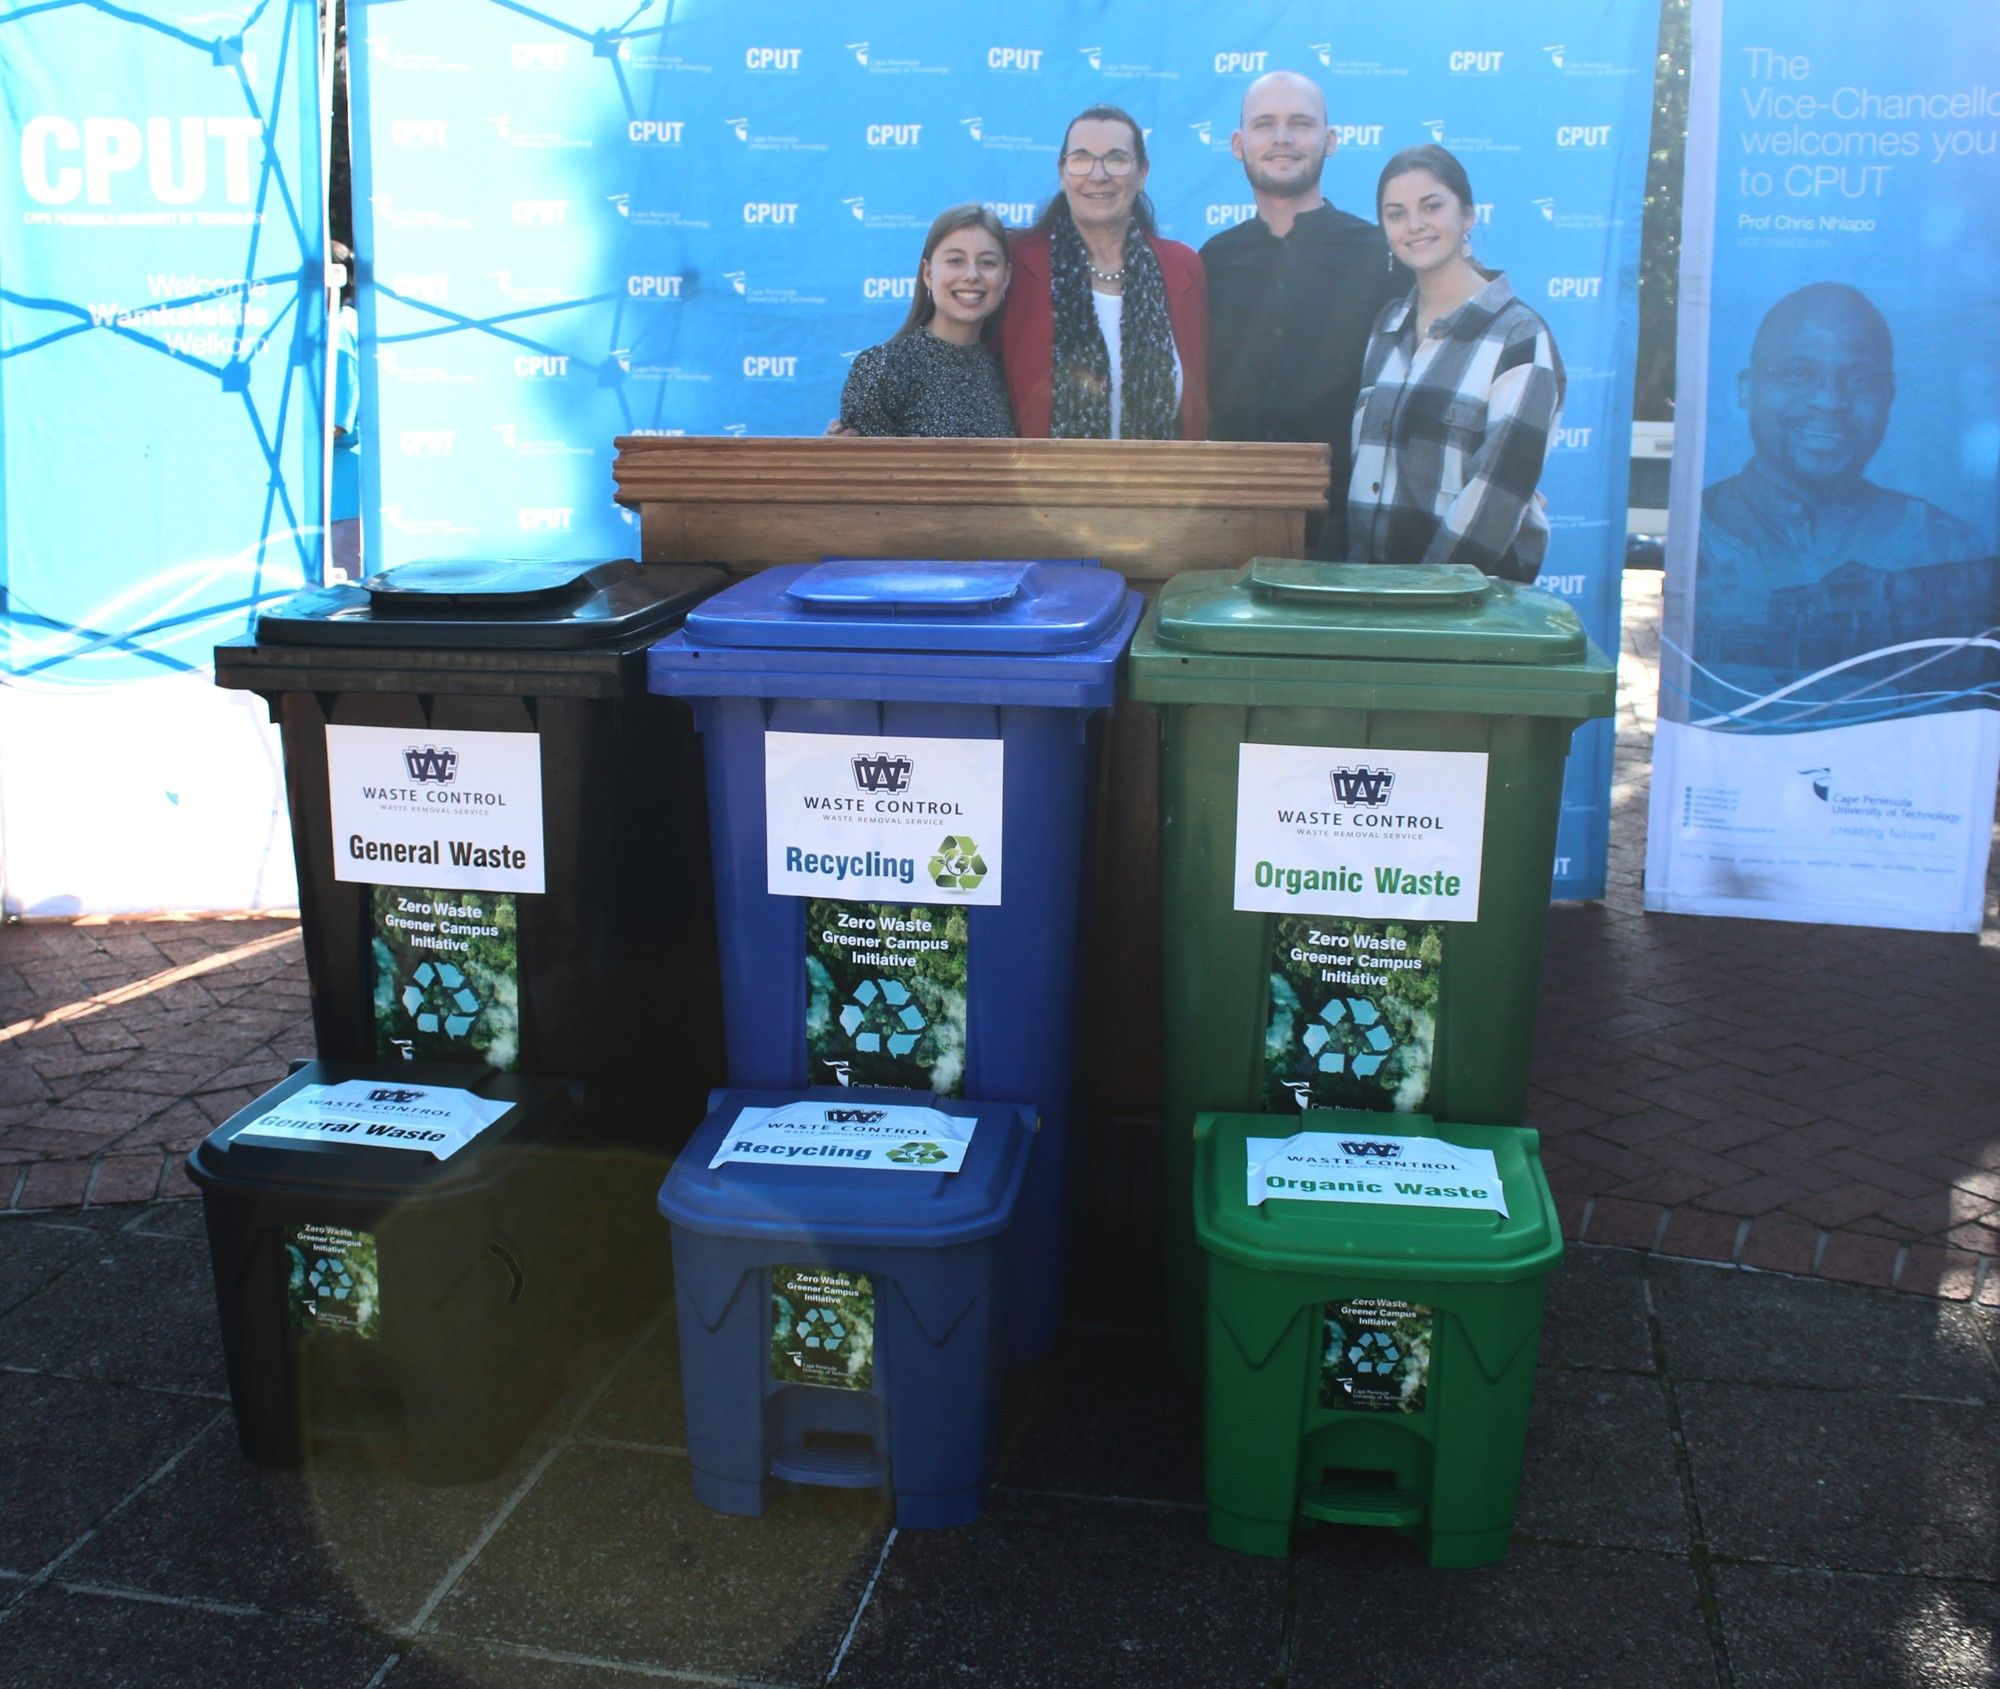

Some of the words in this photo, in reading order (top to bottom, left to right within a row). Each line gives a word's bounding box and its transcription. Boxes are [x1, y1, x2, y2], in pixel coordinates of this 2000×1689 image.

[745, 48, 801, 69] CPUT
[987, 47, 1043, 70] CPUT
[1214, 51, 1268, 73] CPUT
[1450, 51, 1503, 72] CPUT
[1744, 47, 1810, 80] The
[628, 120, 684, 142] CPUT
[866, 124, 922, 145] CPUT
[1556, 126, 1611, 147] CPUT
[1740, 127, 1920, 156] welcomes
[1932, 129, 1998, 163] you
[21, 115, 263, 205] CPUT
[1738, 166, 1772, 197] to
[1784, 164, 1891, 198] CPUT
[743, 203, 798, 224] CPUT
[1738, 214, 1770, 230] Prof
[1775, 214, 1815, 231] Chris
[147, 273, 269, 297] Welcome
[627, 275, 682, 297] CPUT
[863, 277, 916, 299] CPUT
[1548, 277, 1602, 298] CPUT
[163, 331, 269, 356] Welkom
[515, 355, 570, 377] CPUT
[743, 356, 798, 378] CPUT
[1552, 428, 1592, 448] PUT
[519, 508, 574, 530] CPUT
[362, 787, 417, 801] WASTE
[426, 790, 506, 806] CONTROL
[803, 796, 865, 812] WASTE
[875, 799, 964, 816] CONTROL
[1833, 793, 1859, 805] Cape
[1864, 795, 1913, 808] Peninsula
[379, 804, 408, 812] WASTE
[411, 806, 450, 814] REMOVAL
[454, 808, 489, 816] SERVICE
[822, 814, 853, 823] WASTE
[857, 816, 902, 825] REMOVAL
[905, 818, 944, 826] SERVICE
[1278, 810, 1342, 826] WASTE
[1353, 813, 1444, 830] CONTROL
[1832, 805, 1882, 818] University
[1887, 808, 1897, 817] of
[1901, 809, 1961, 824] Technology
[1296, 828, 1329, 837] WASTE
[1334, 830, 1380, 839] REMOVAL
[1383, 832, 1424, 841] SERVICE
[349, 834, 440, 865] General
[449, 841, 526, 870] Waste
[785, 846, 915, 884] Recycling
[1255, 860, 1363, 896] Organic
[1374, 867, 1461, 897] Waste
[397, 897, 431, 915] Zero
[434, 902, 483, 919] Waste
[385, 914, 436, 932] Greener
[440, 921, 499, 938] Campus
[837, 913, 876, 930] Zero
[879, 917, 932, 933] Waste
[410, 934, 469, 952] Initiative
[822, 931, 881, 948] Greener
[886, 937, 949, 952] Campus
[1308, 930, 1349, 948] Zero
[1353, 934, 1407, 951] Waste
[852, 951, 917, 967] Initiative
[1290, 947, 1353, 966] Greener
[1358, 954, 1423, 972] Campus
[1321, 969, 1389, 986] Initiative
[309, 1099, 365, 1109] WASTE
[372, 1104, 453, 1118] CONTROL
[258, 1115, 358, 1133] General
[365, 1123, 447, 1142] Waste
[768, 1122, 831, 1131] WASTE
[841, 1125, 931, 1137] CONTROL
[733, 1141, 872, 1162] Recycling
[1286, 1155, 1354, 1166] WASTE
[1365, 1158, 1461, 1171] CONTROL
[1266, 1175, 1383, 1194] Organic
[1394, 1182, 1488, 1200] Waste
[297, 1232, 328, 1244] Greener
[329, 1237, 362, 1248] Campus
[304, 1223, 325, 1234] Zero
[326, 1225, 353, 1237] Waste
[313, 1243, 346, 1254] Initiative
[787, 1282, 822, 1293] Greener
[823, 1286, 860, 1297] Campus
[796, 1273, 819, 1284] Zero
[820, 1276, 850, 1287] Waste
[804, 1293, 841, 1304] Initiative
[1352, 1299, 1375, 1307] Zero
[1376, 1299, 1408, 1309] Waste
[1341, 1306, 1377, 1317] Greener
[1379, 1309, 1417, 1319] Campus
[1359, 1317, 1398, 1327] Initiative
